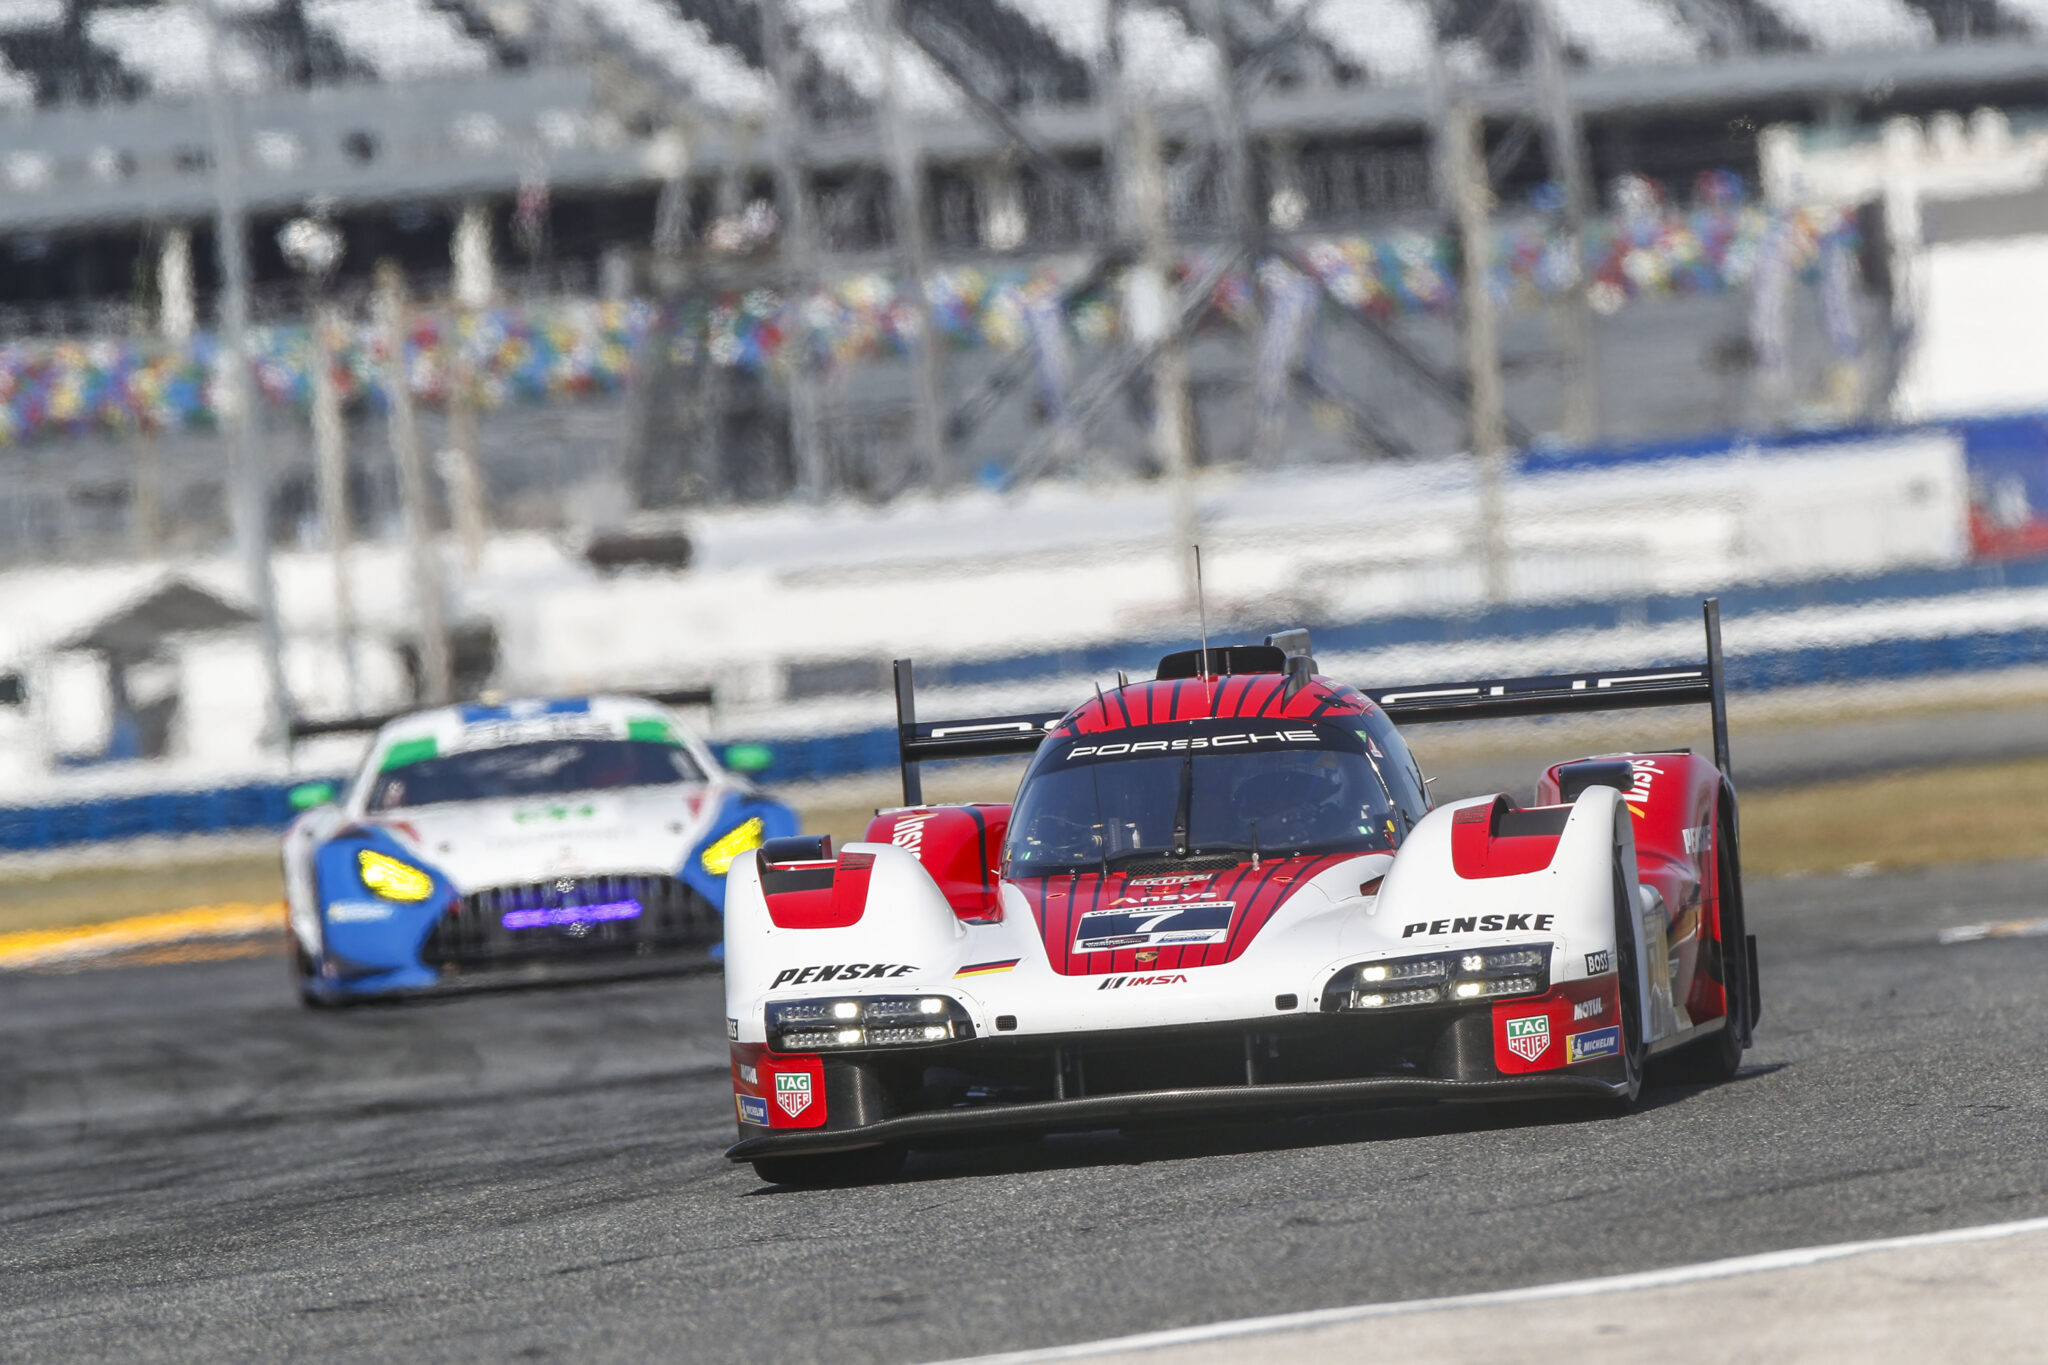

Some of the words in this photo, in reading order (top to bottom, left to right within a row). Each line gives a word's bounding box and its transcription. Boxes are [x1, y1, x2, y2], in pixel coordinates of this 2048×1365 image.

[1066, 729, 1321, 761] PORSCHE
[1109, 892, 1217, 905] Ansys
[1129, 909, 1185, 933] 7
[1401, 913, 1555, 939] PENSKE
[1587, 953, 1608, 973] BOSS
[769, 963, 922, 990] PENSKE
[1126, 974, 1188, 987] IMSA
[1574, 997, 1602, 1021] MOTUL
[1510, 1019, 1546, 1036] TAG
[1511, 1035, 1548, 1058] HEUER
[1583, 1036, 1615, 1052] MICHELIN
[778, 1076, 808, 1091] TAG
[778, 1092, 810, 1115] HEUER
